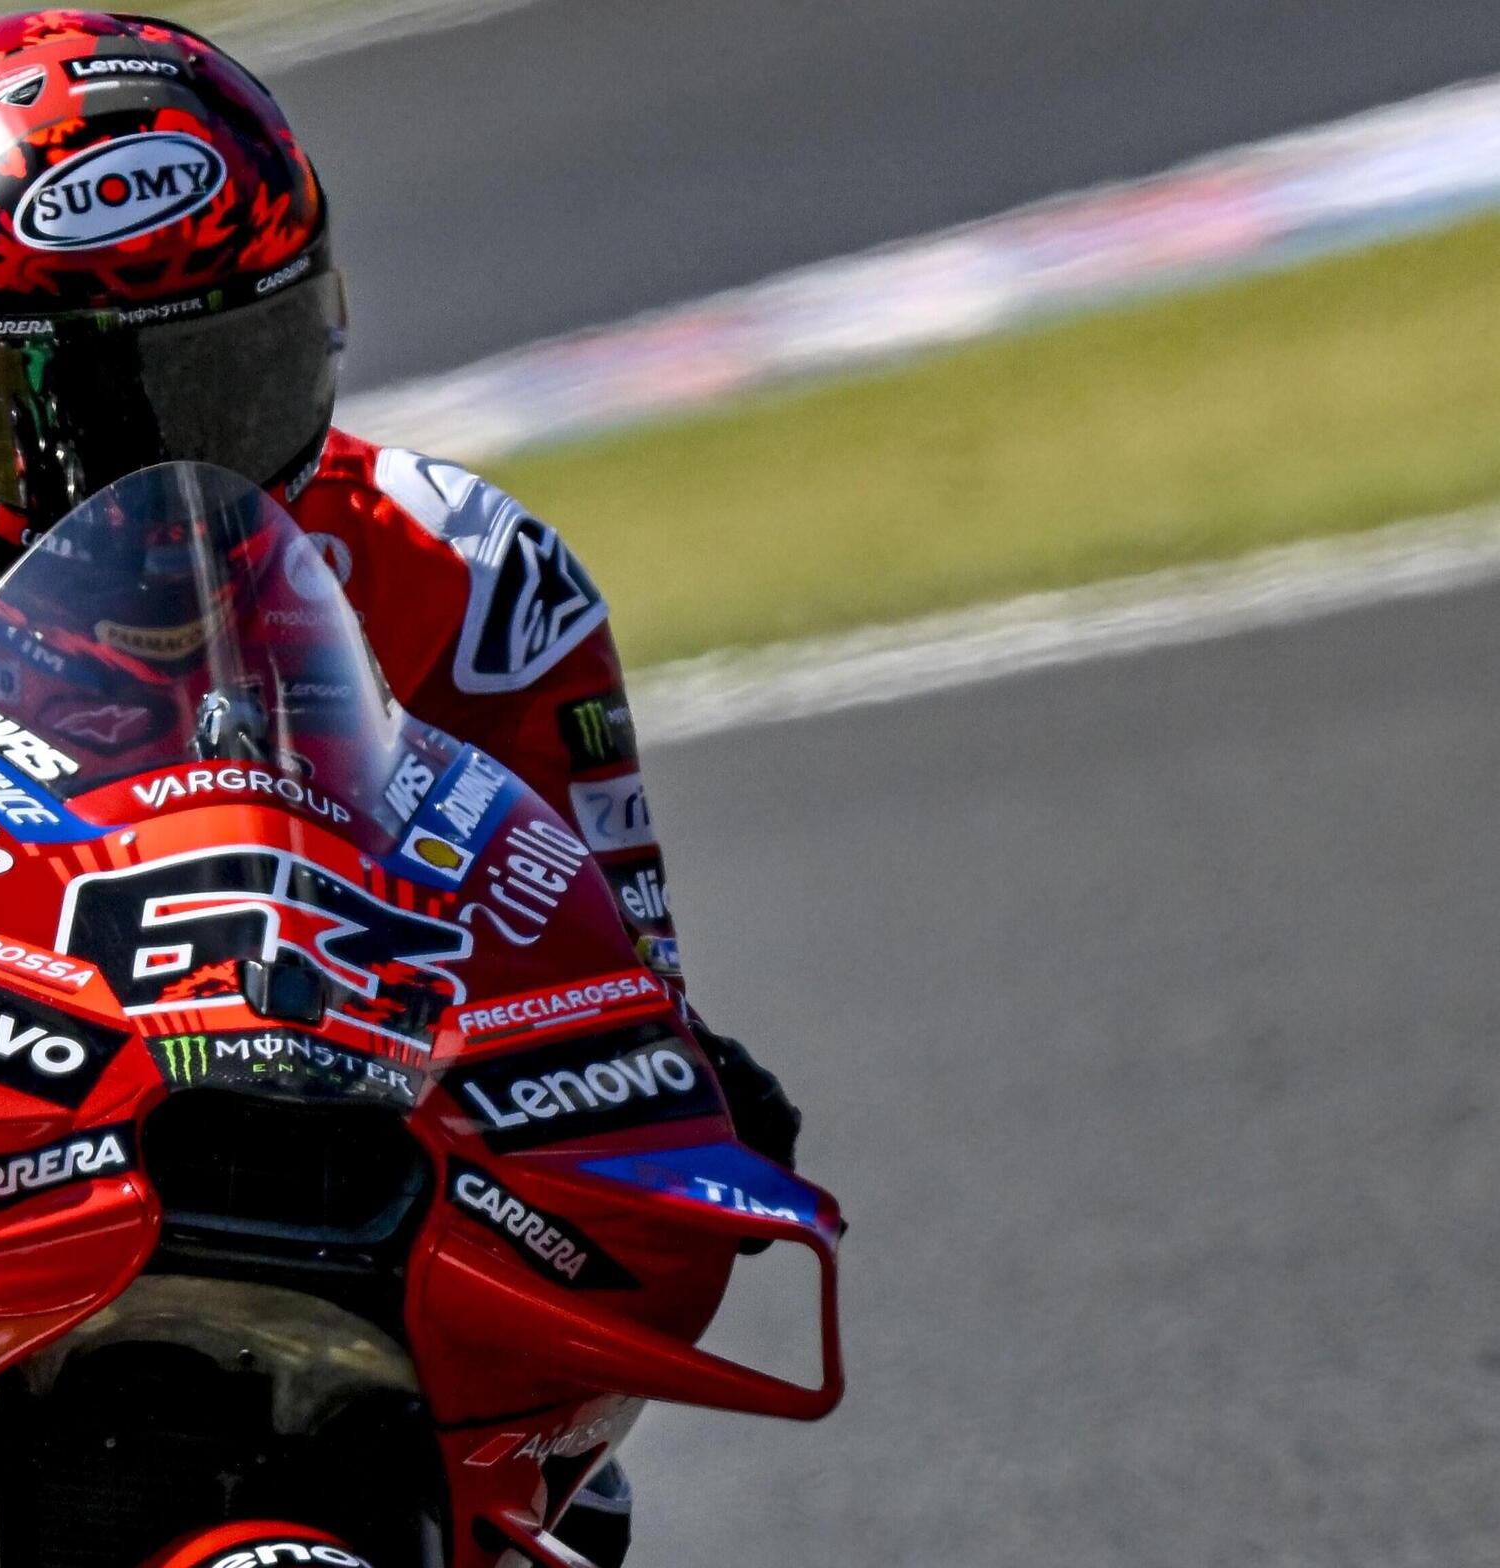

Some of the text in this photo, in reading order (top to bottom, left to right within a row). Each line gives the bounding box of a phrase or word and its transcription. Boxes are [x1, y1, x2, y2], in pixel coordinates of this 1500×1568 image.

[71, 59, 179, 77] Lenovo
[37, 162, 206, 222] SUOMY
[132, 768, 351, 824] VARGROUP
[457, 975, 659, 1034] FRECCIAROSSA
[215, 1033, 415, 1098] MONSTER
[462, 1048, 696, 1129] Lenovo
[455, 1173, 589, 1281] CARRERA
